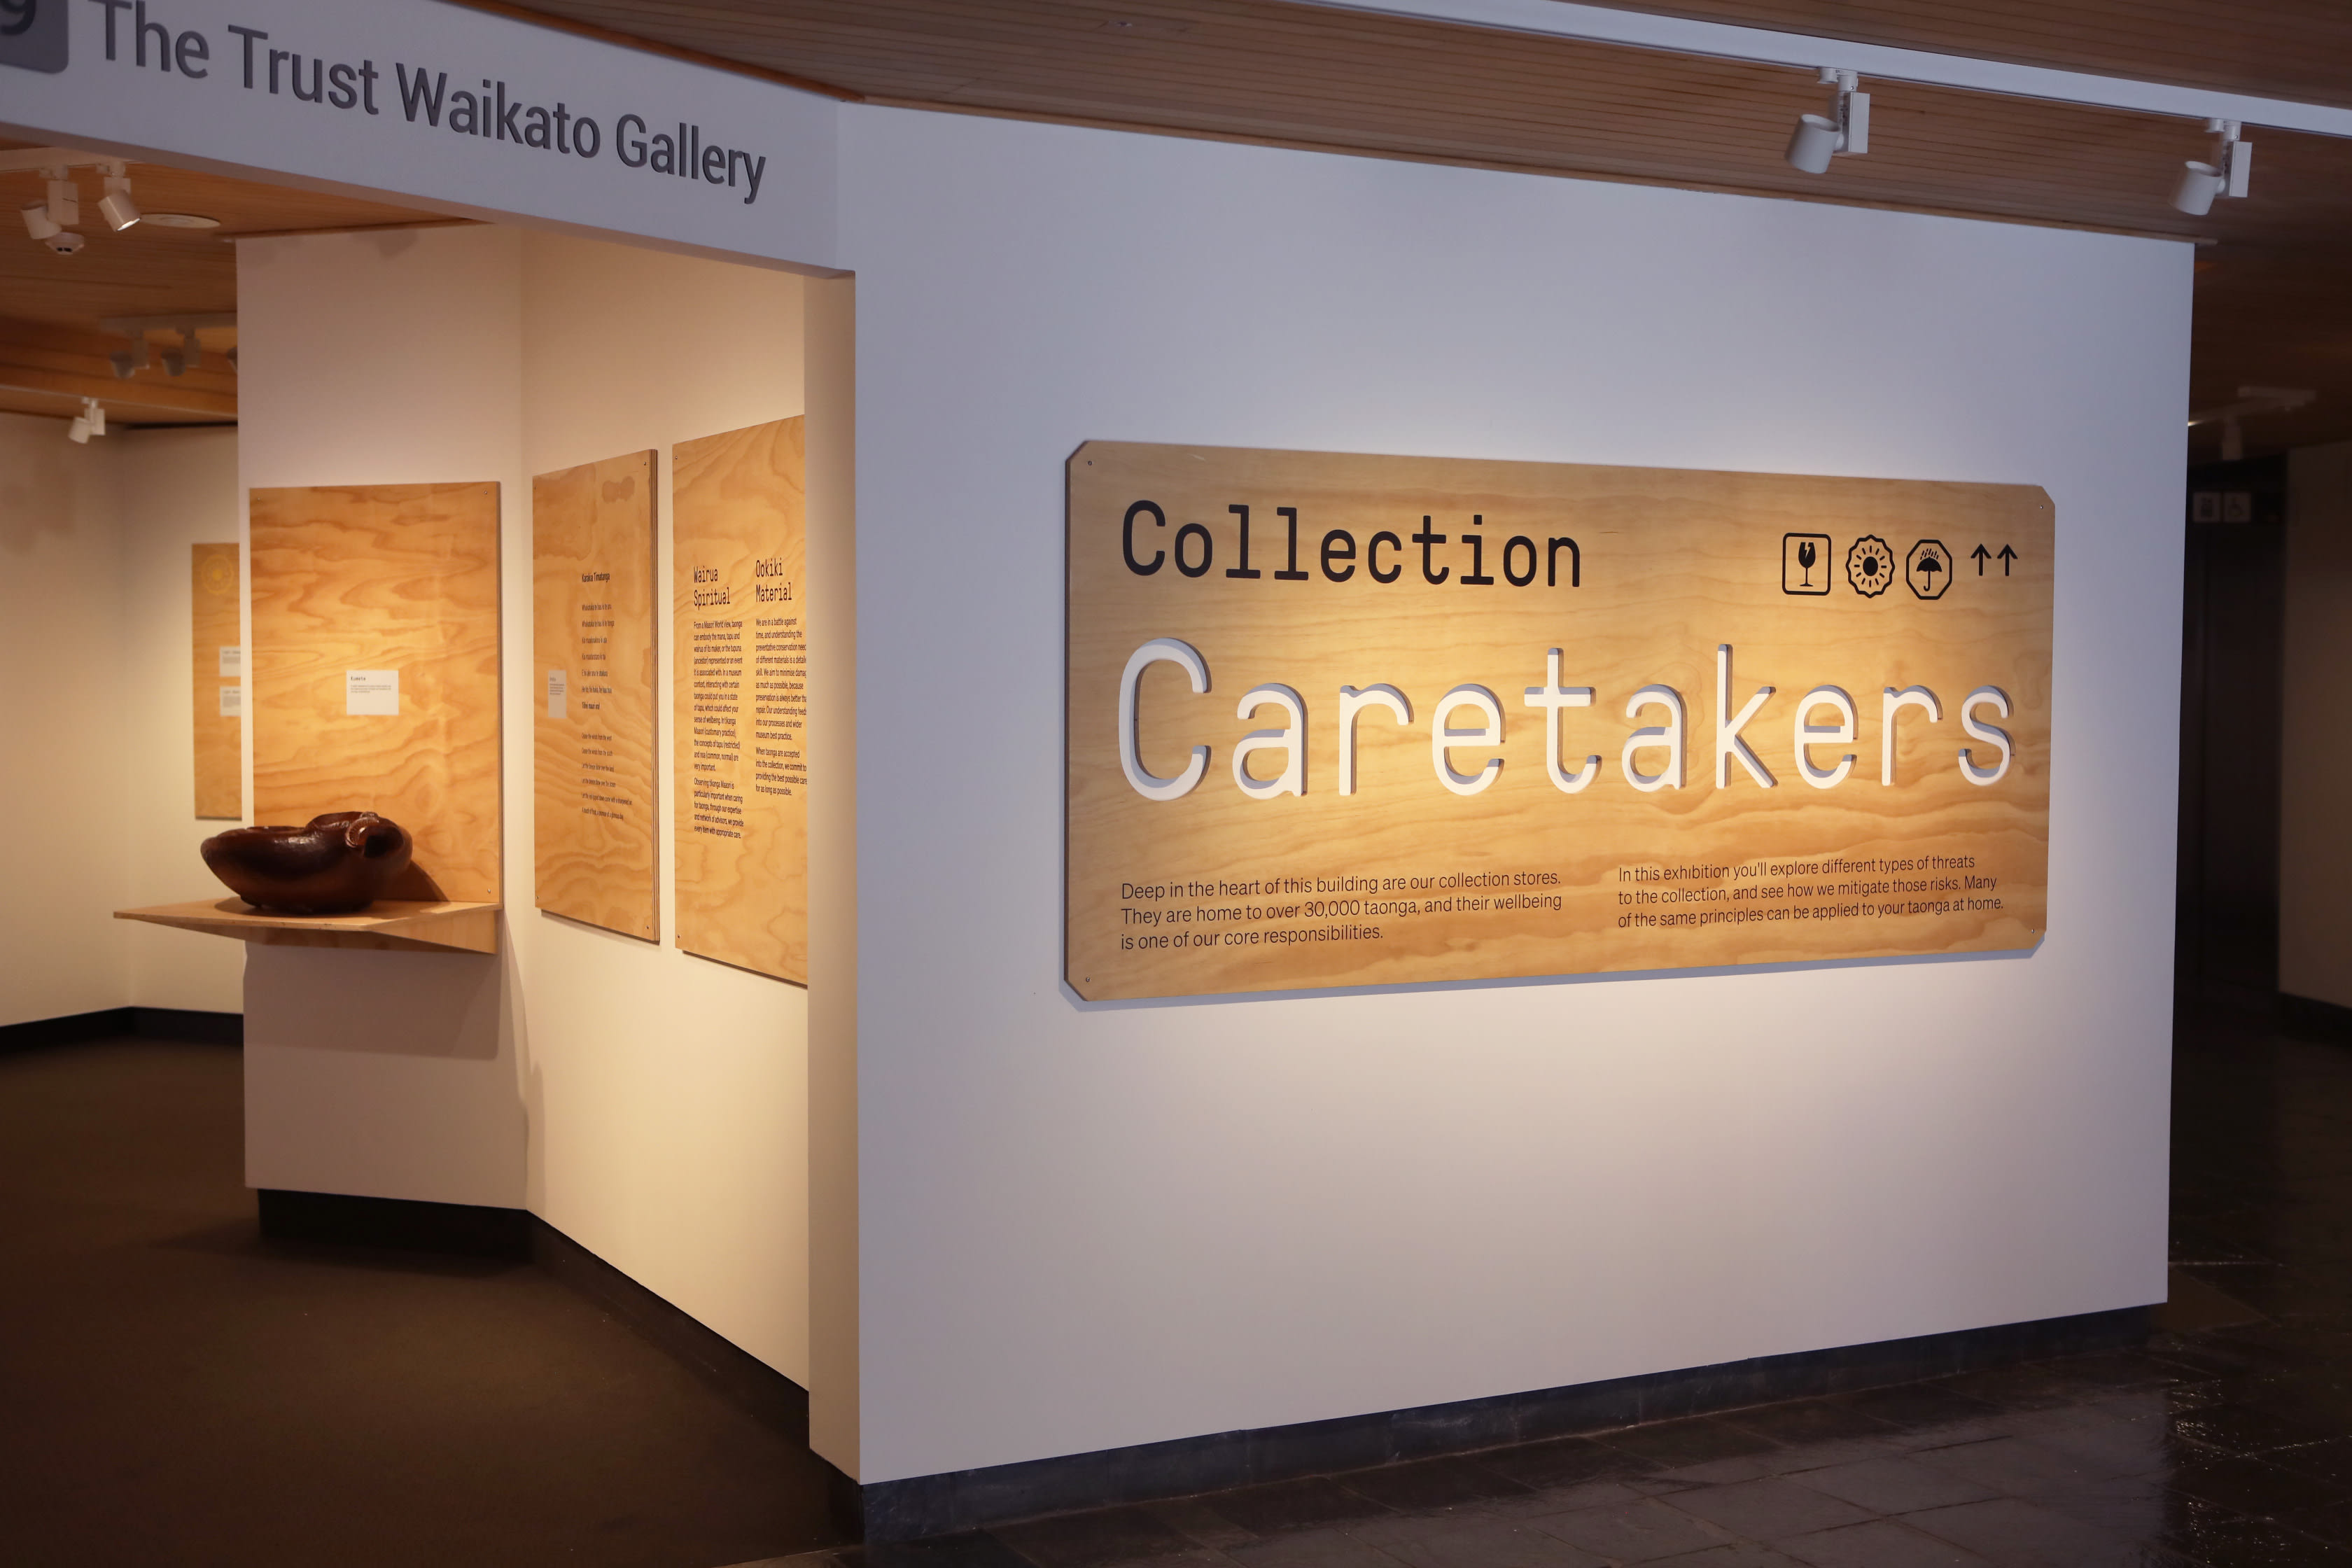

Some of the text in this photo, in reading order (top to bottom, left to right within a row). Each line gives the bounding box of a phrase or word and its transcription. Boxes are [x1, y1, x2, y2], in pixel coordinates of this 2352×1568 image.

[88, 0, 767, 206] The Trust Waikato Gallery
[1122, 500, 1581, 589] Collection
[694, 566, 718, 583] Wairua
[756, 558, 783, 578] Ookiki
[694, 587, 730, 610] Spiritual
[756, 582, 792, 602] Material
[771, 630, 795, 639] understanding
[784, 617, 797, 626] against
[1118, 637, 2015, 802] Caretakers
[766, 748, 777, 757] taonga
[784, 750, 799, 759] accepted
[1618, 855, 1975, 883] In this exhibition you'll explore different types of threats
[1122, 871, 1561, 902] Deep in the heart of this building are our collection stores.
[1618, 876, 1997, 906] to the collection, and see how we mitigate those risks. Many
[1121, 892, 1562, 927] They are home to over 30,000 taonga, and their wellbeing
[1618, 897, 2003, 929] of the same principles can be applied to your taonga at home.
[1121, 923, 1383, 951] is one of our core responsibilities.
